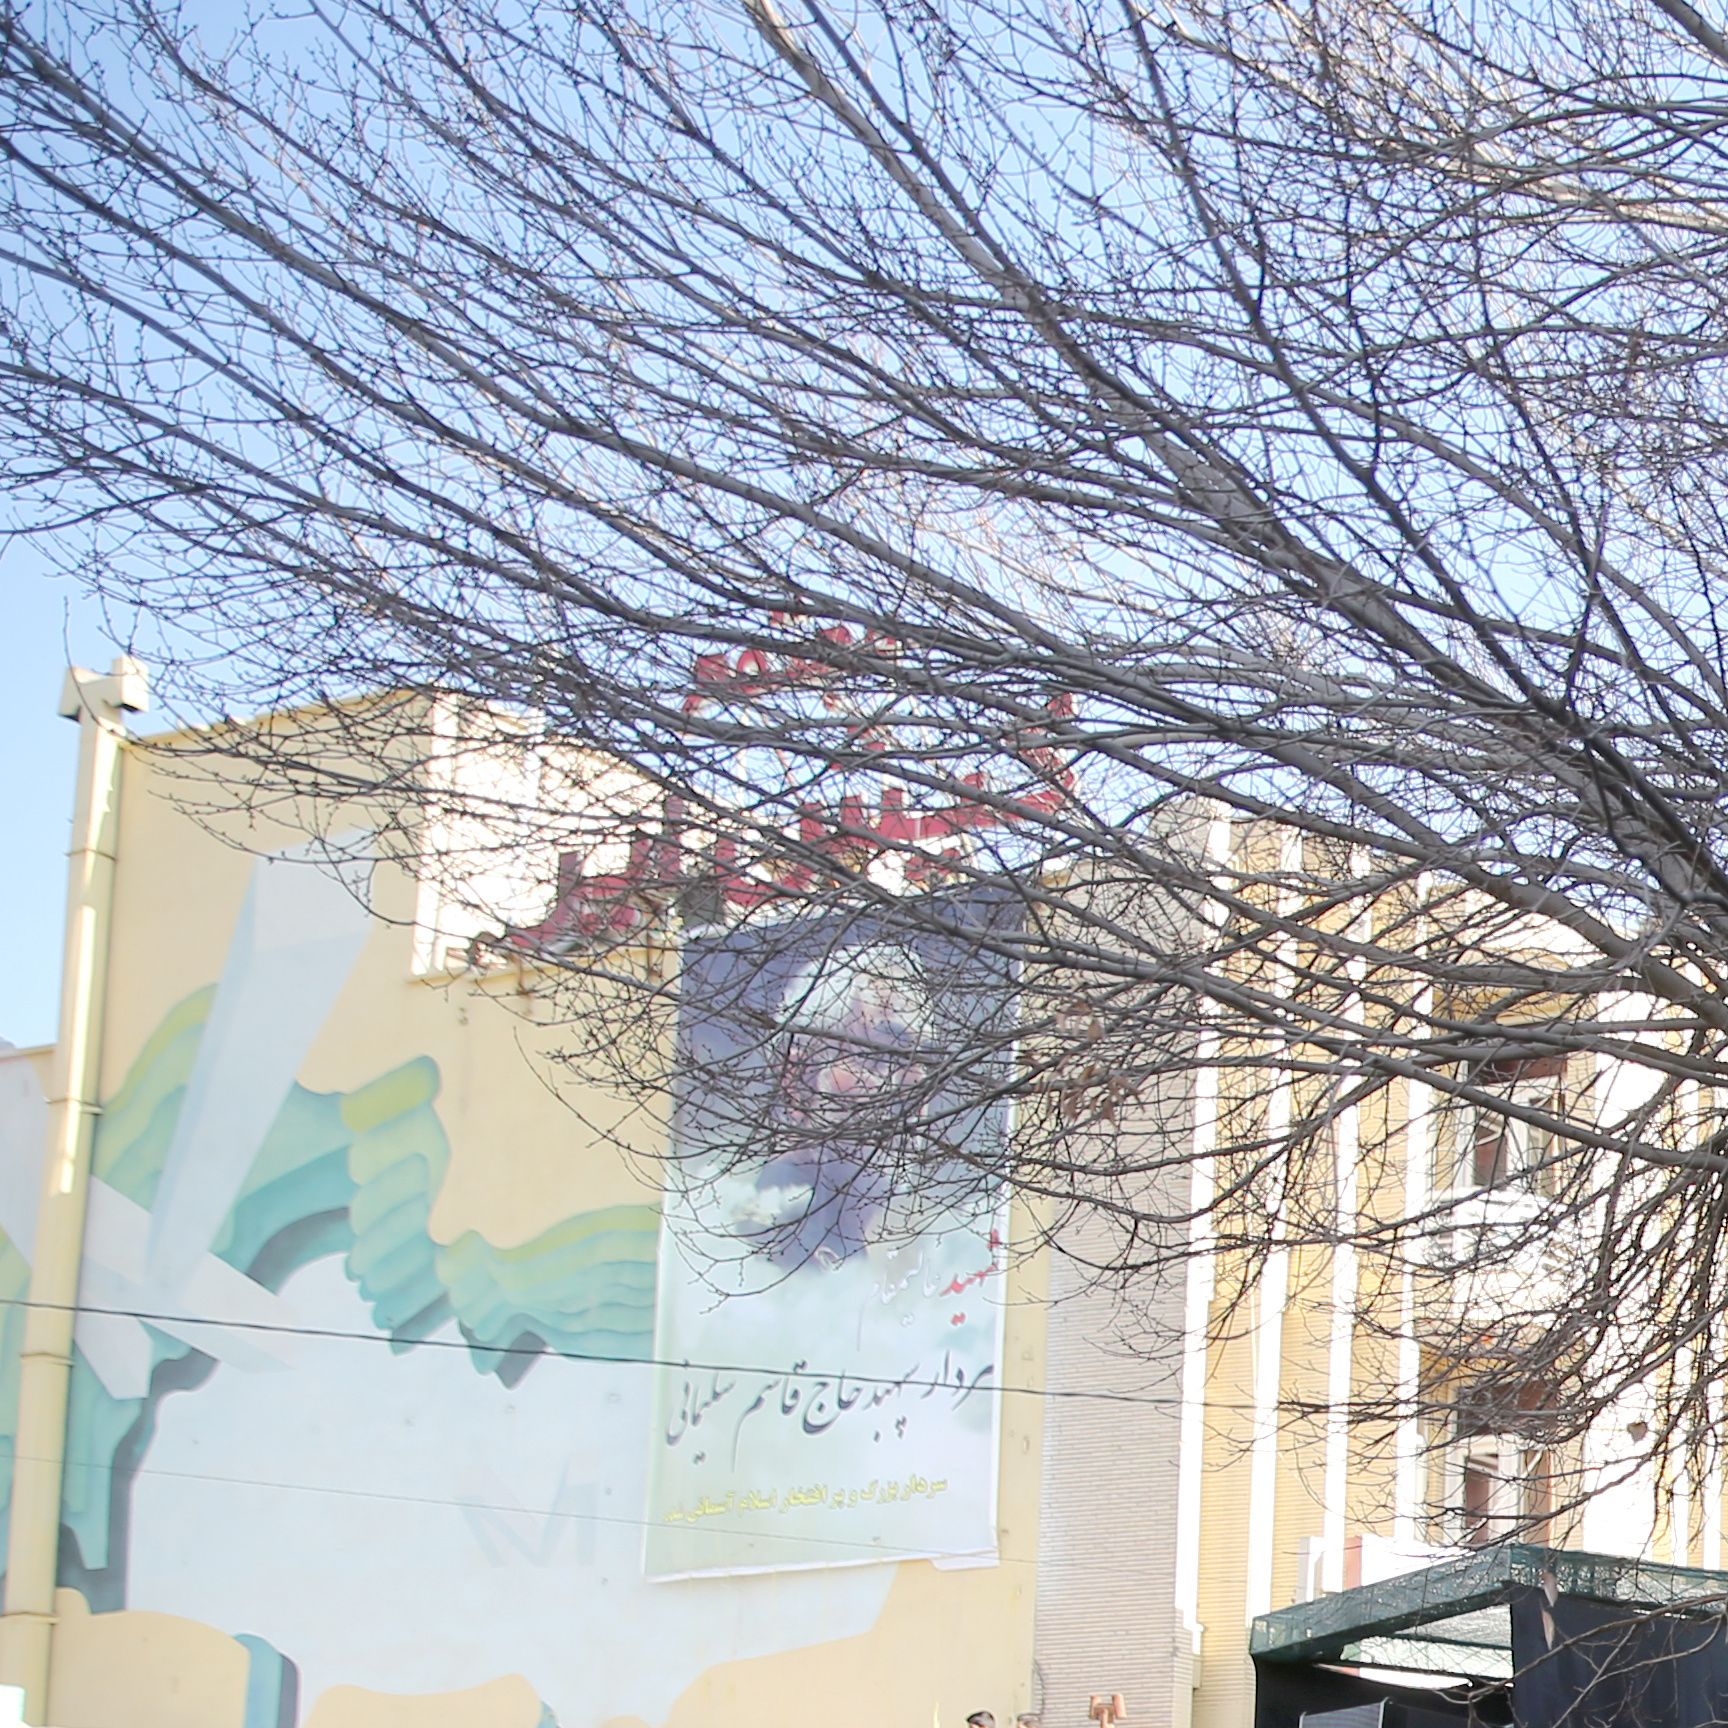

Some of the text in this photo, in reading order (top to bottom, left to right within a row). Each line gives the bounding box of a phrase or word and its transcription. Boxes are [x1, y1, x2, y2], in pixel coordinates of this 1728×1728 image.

[665, 1349, 994, 1473] سردار سپهبد حاج قاسم سلیمانی
